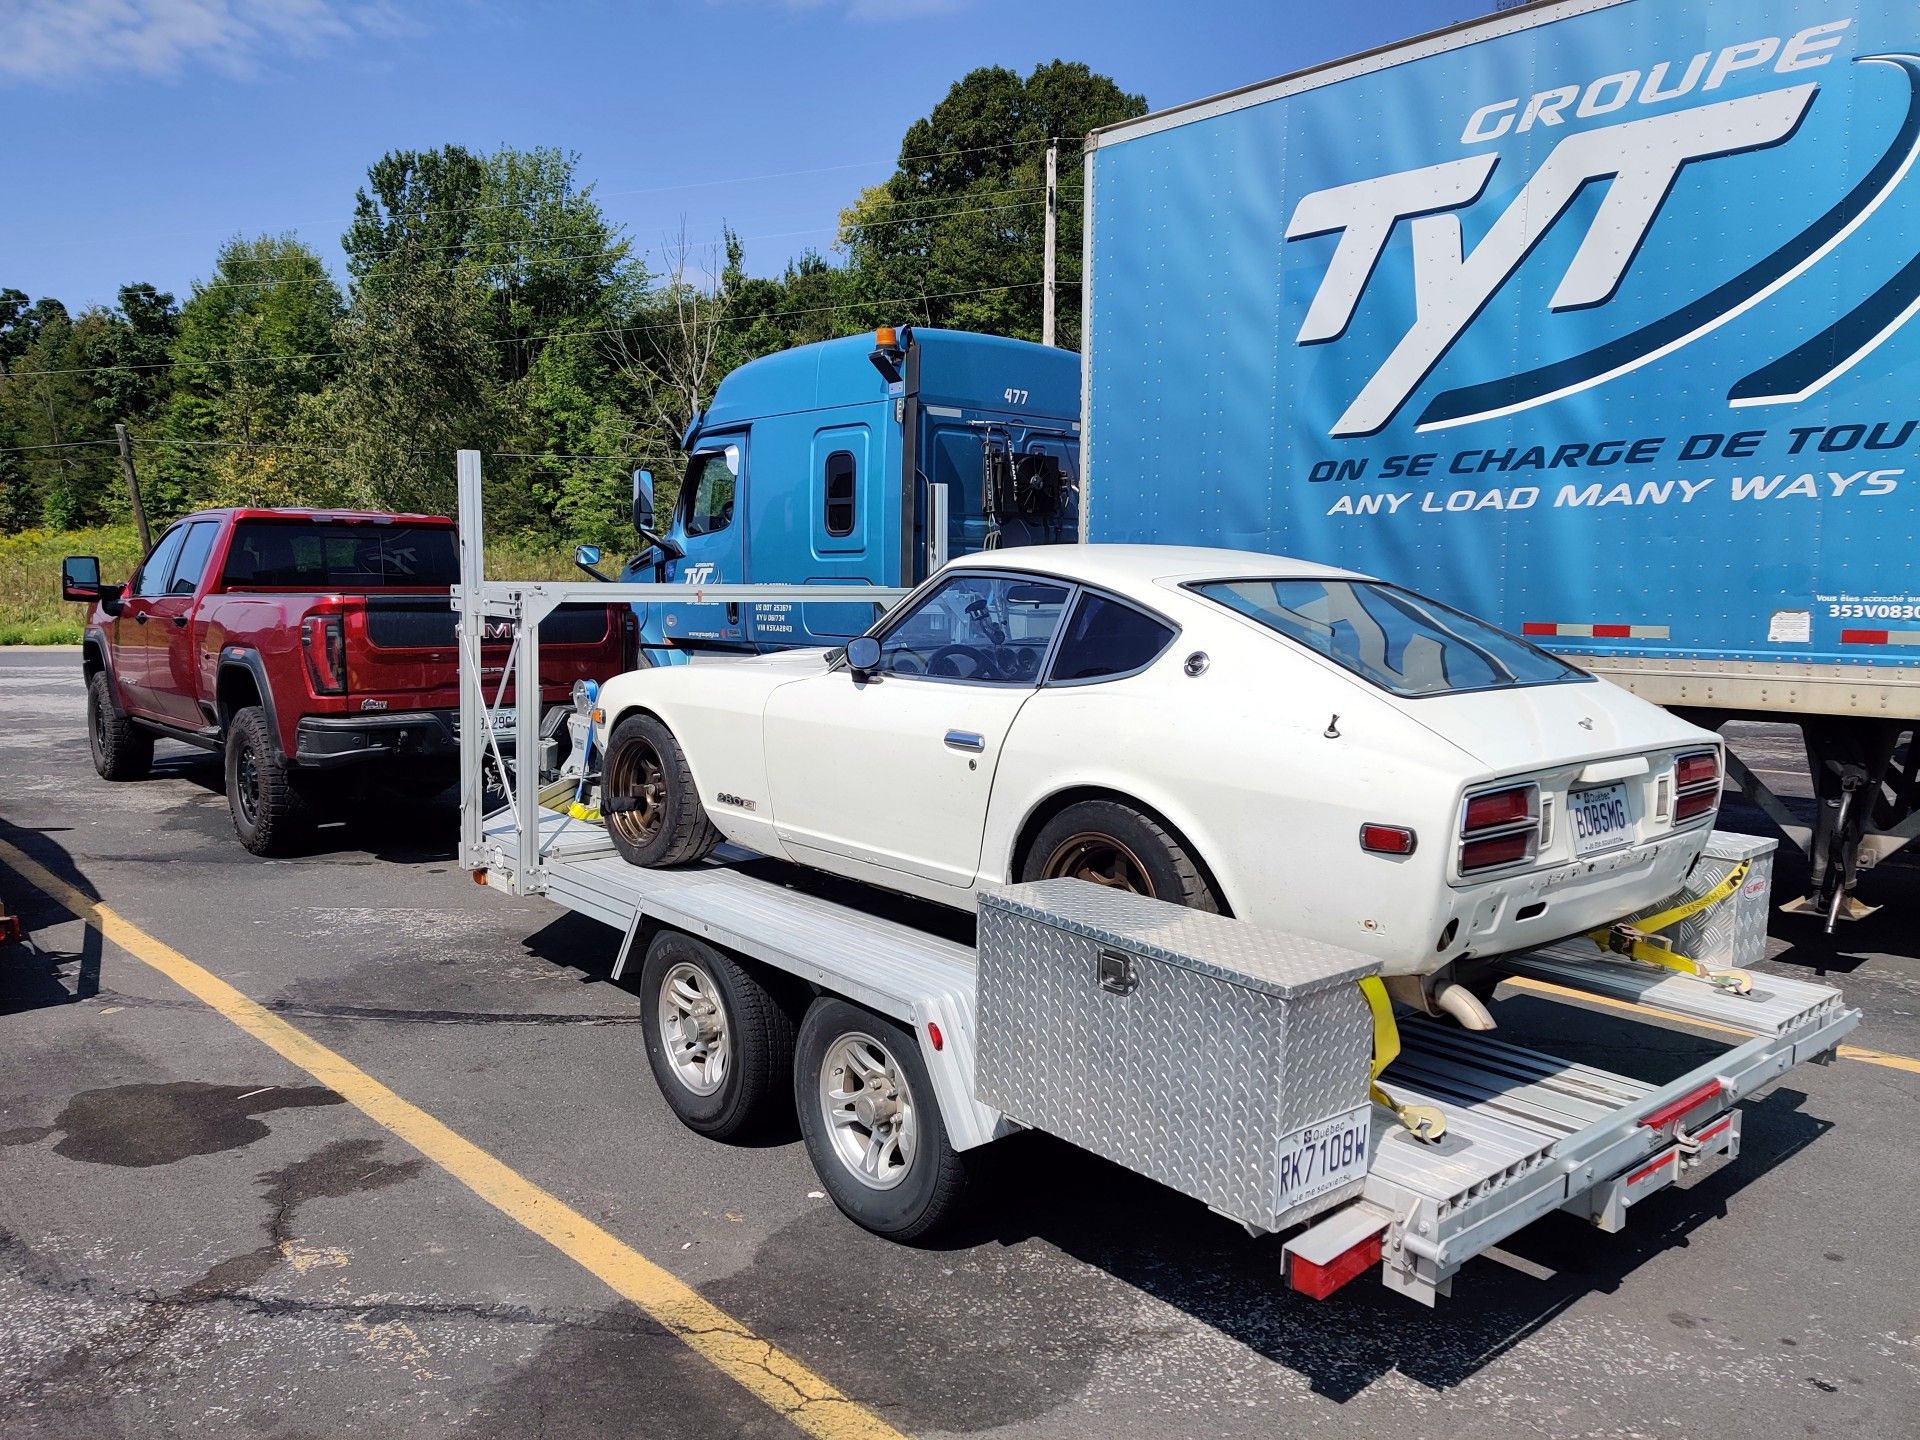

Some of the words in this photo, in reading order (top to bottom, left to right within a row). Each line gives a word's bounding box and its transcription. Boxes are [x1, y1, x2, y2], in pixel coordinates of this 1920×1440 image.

[1460, 18, 1852, 144] GROUPE
[1004, 388, 1029, 405] 477
[1308, 458, 1369, 483] ON
[1378, 453, 1438, 479] SE
[1448, 437, 1666, 474] CHARGE
[1677, 430, 1767, 461] DE
[1787, 420, 1920, 455] TOU
[1326, 492, 1413, 516] ANY
[1421, 487, 1540, 512] LOAD
[1553, 478, 1716, 507] MANY
[1731, 469, 1905, 501] WAYS
[1816, 594, 1837, 602] Vous
[1313, 1122, 1345, 1140] Québec
[1280, 1124, 1367, 1196] RK7108W
